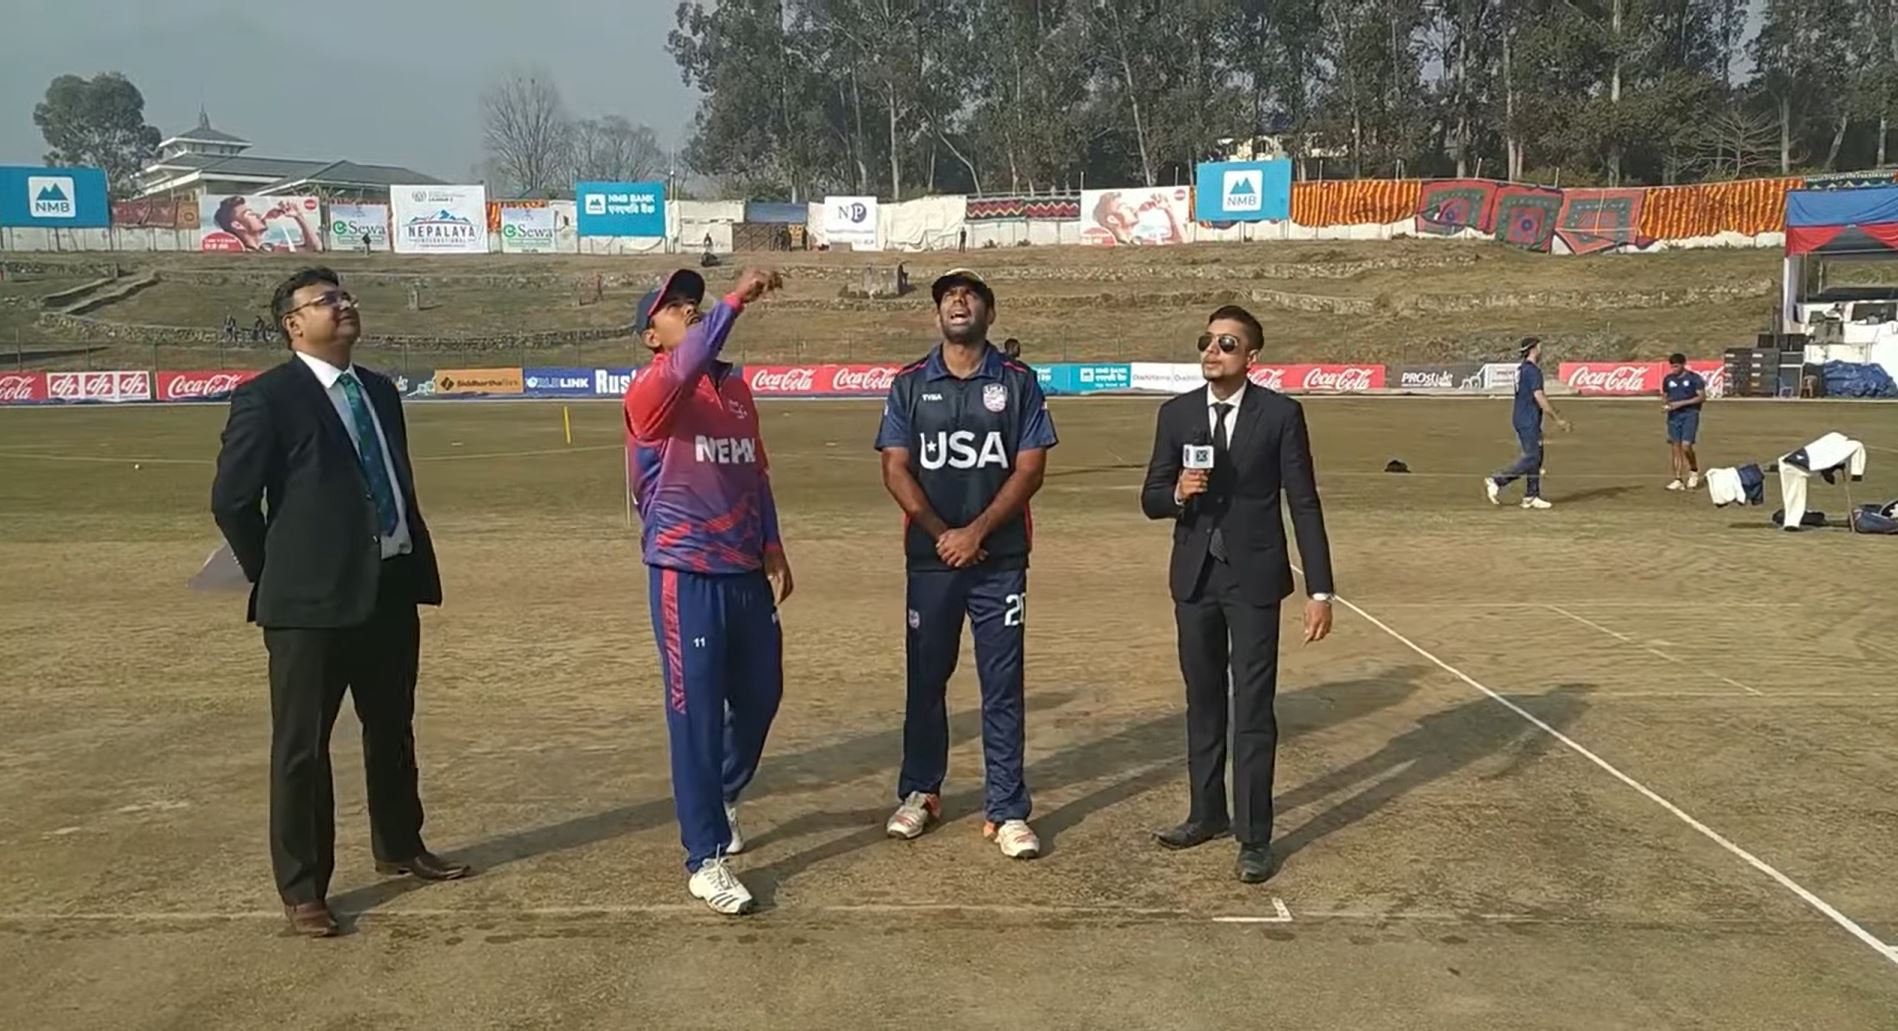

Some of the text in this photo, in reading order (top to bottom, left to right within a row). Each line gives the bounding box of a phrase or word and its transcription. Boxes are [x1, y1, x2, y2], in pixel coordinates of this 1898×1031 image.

[35, 202, 70, 213] NMB
[1227, 196, 1257, 207] NMB
[408, 225, 475, 237] NEPALAYA
[595, 369, 637, 394] Rus
[752, 369, 816, 390] Coca-Cola
[1303, 368, 1374, 390] Coca-Cola
[1568, 366, 1649, 391] Coca-Cola
[919, 430, 1009, 470] USA
[693, 637, 706, 648] 11
